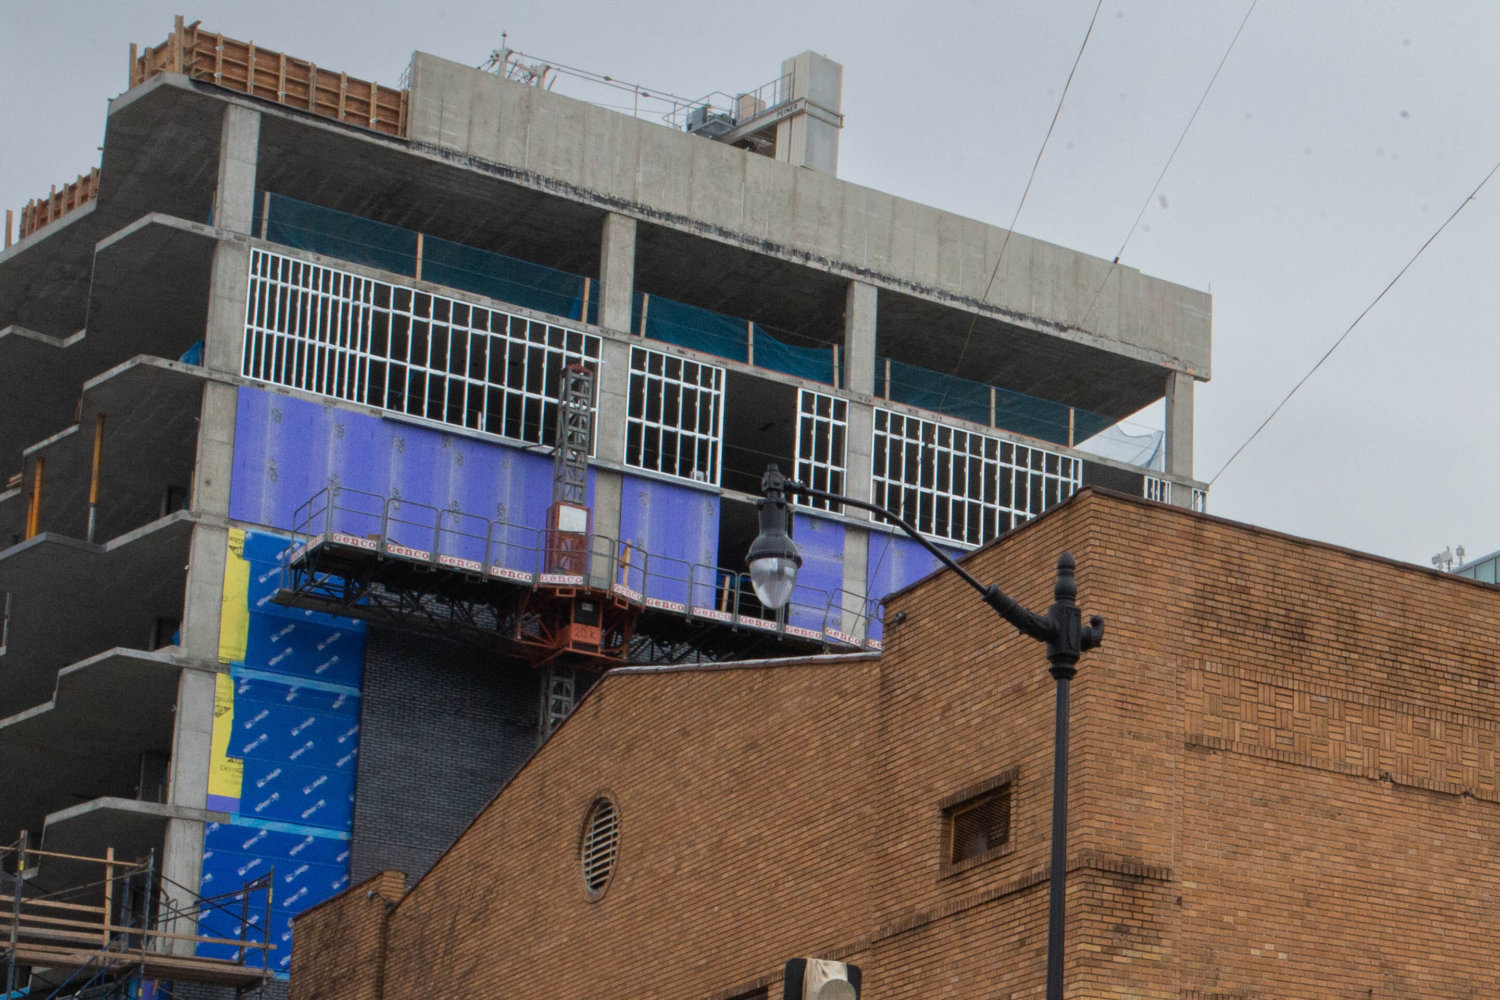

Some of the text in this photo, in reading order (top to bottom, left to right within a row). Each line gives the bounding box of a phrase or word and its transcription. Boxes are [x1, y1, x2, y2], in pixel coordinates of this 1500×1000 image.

[333, 533, 377, 550] Genco
[387, 543, 430, 560] Genco
[440, 554, 482, 570] Genco
[492, 566, 532, 581] Genco
[540, 574, 583, 584] Genco
[647, 598, 684, 611] Genco
[694, 607, 731, 621] Genco
[741, 615, 777, 630] Genco
[786, 626, 822, 639] Genco
